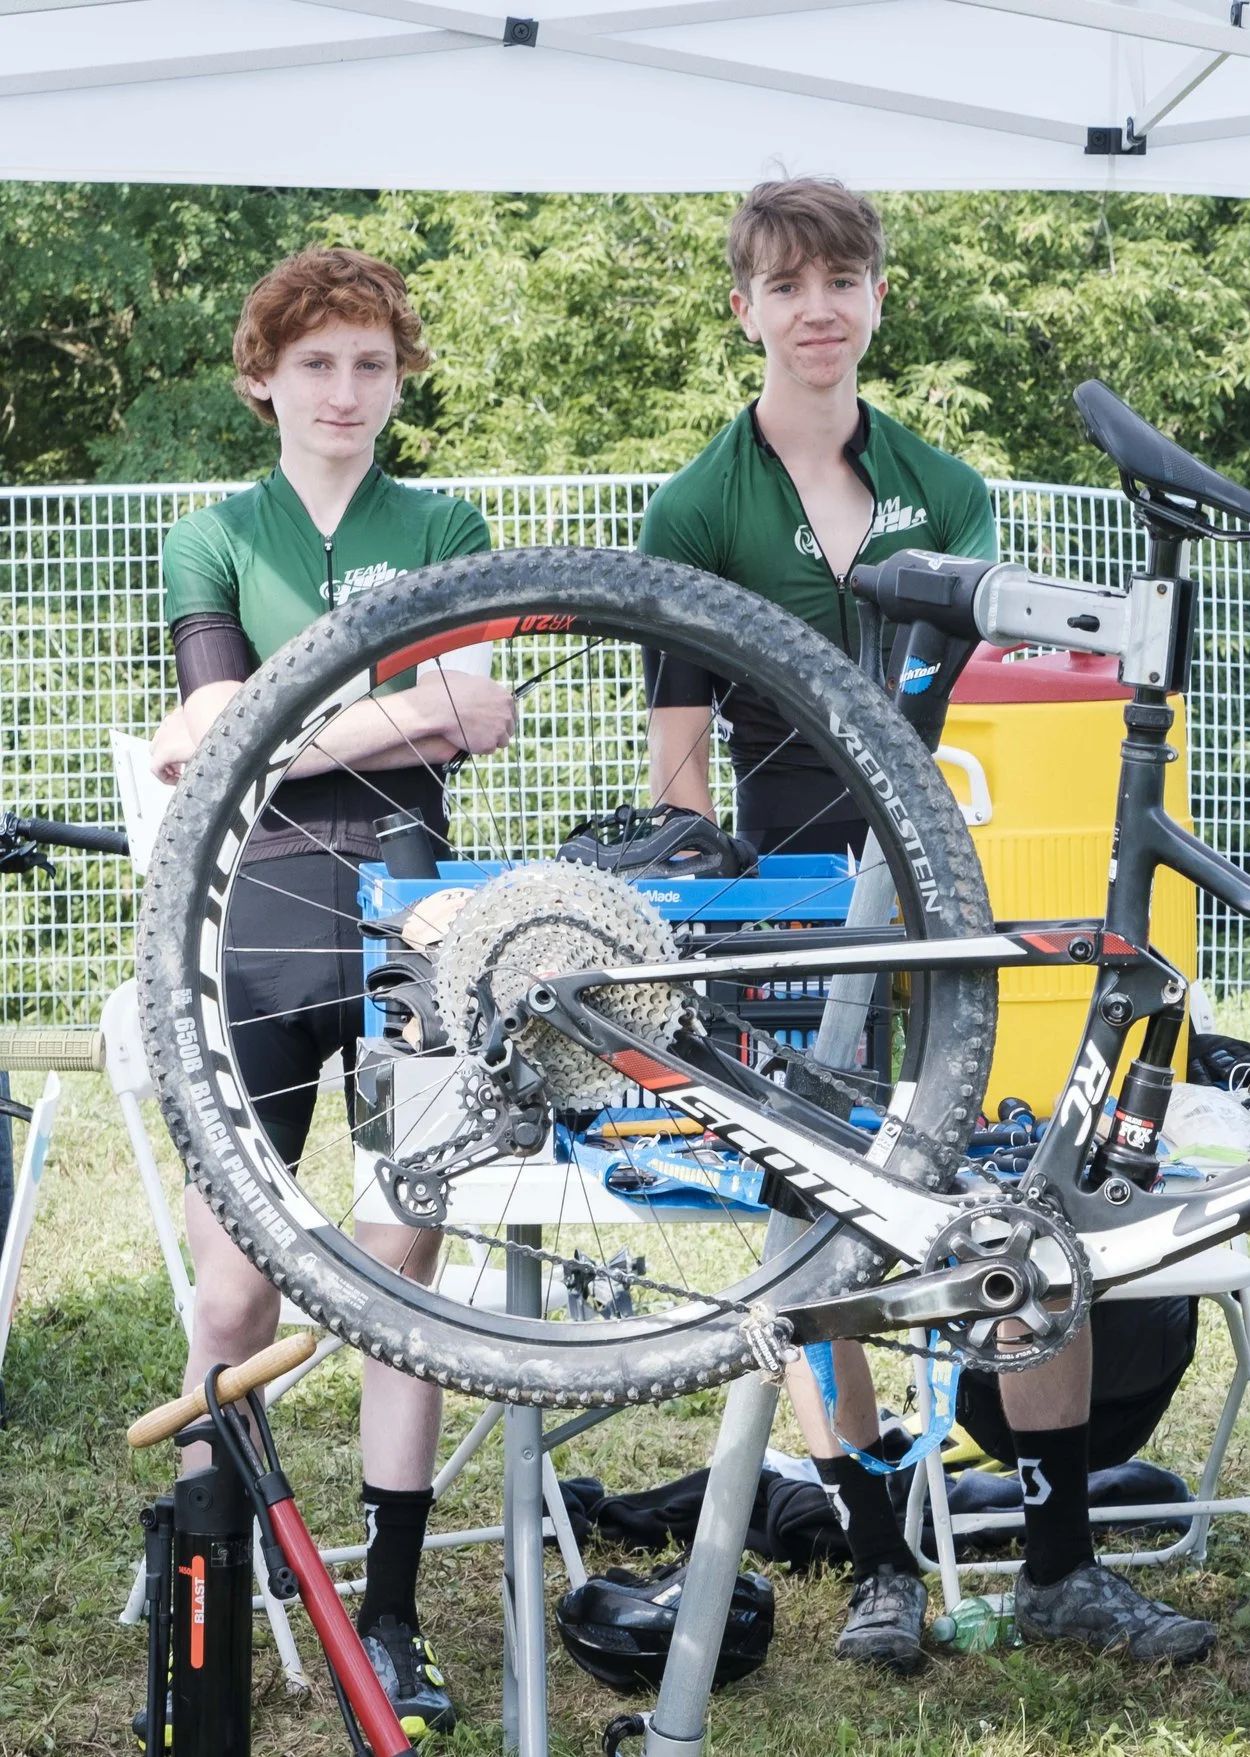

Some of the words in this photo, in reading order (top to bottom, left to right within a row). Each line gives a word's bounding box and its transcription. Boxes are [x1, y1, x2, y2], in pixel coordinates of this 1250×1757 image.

[344, 561, 388, 580] TEAM
[829, 710, 943, 914] VREDESTEIN
[174, 1016, 204, 1074] 650B
[189, 1080, 236, 1158] BLACK
[222, 1156, 298, 1250] PANTHER
[672, 1095, 888, 1222] SCOTT
[1117, 1120, 1153, 1149] FOX
[194, 1576, 205, 1624] BLAST
